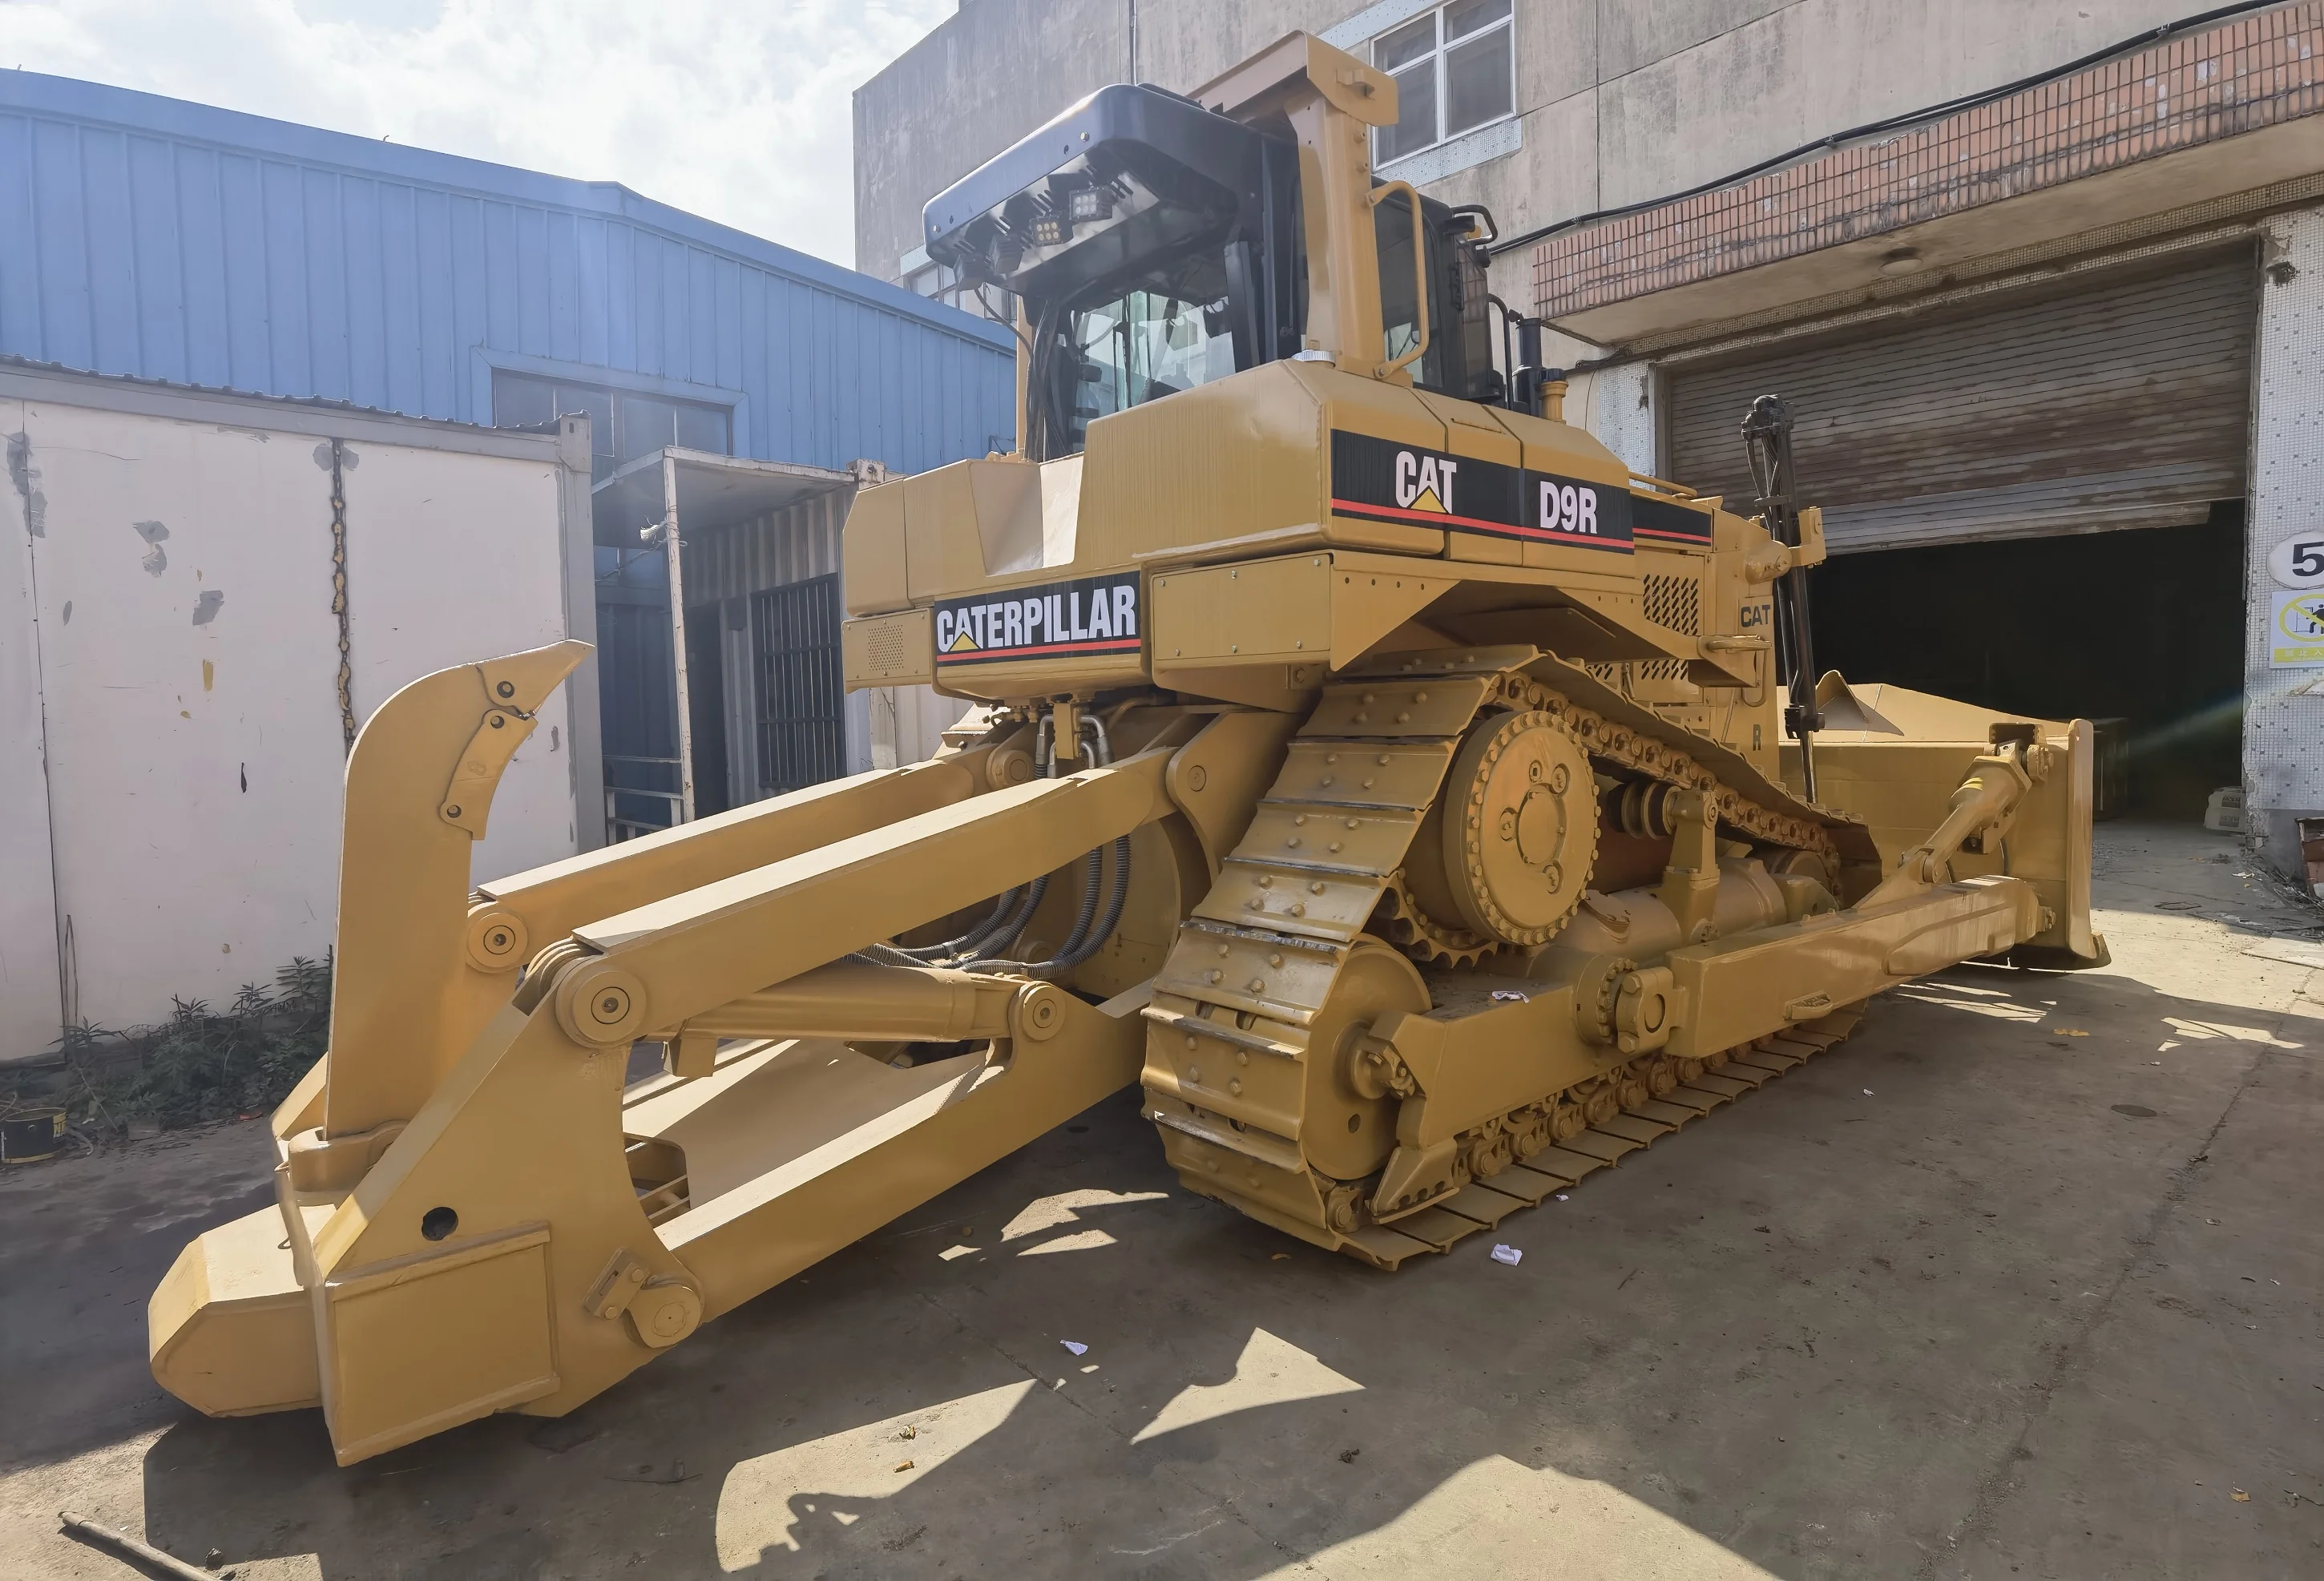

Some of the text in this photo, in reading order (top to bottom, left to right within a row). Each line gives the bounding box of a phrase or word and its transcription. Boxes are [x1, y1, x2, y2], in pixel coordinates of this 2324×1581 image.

[1395, 450, 1457, 514] CAT
[1539, 480, 1598, 534] D9R
[936, 585, 1136, 653] CATERPILLAR
[1741, 604, 1771, 628] CAT
